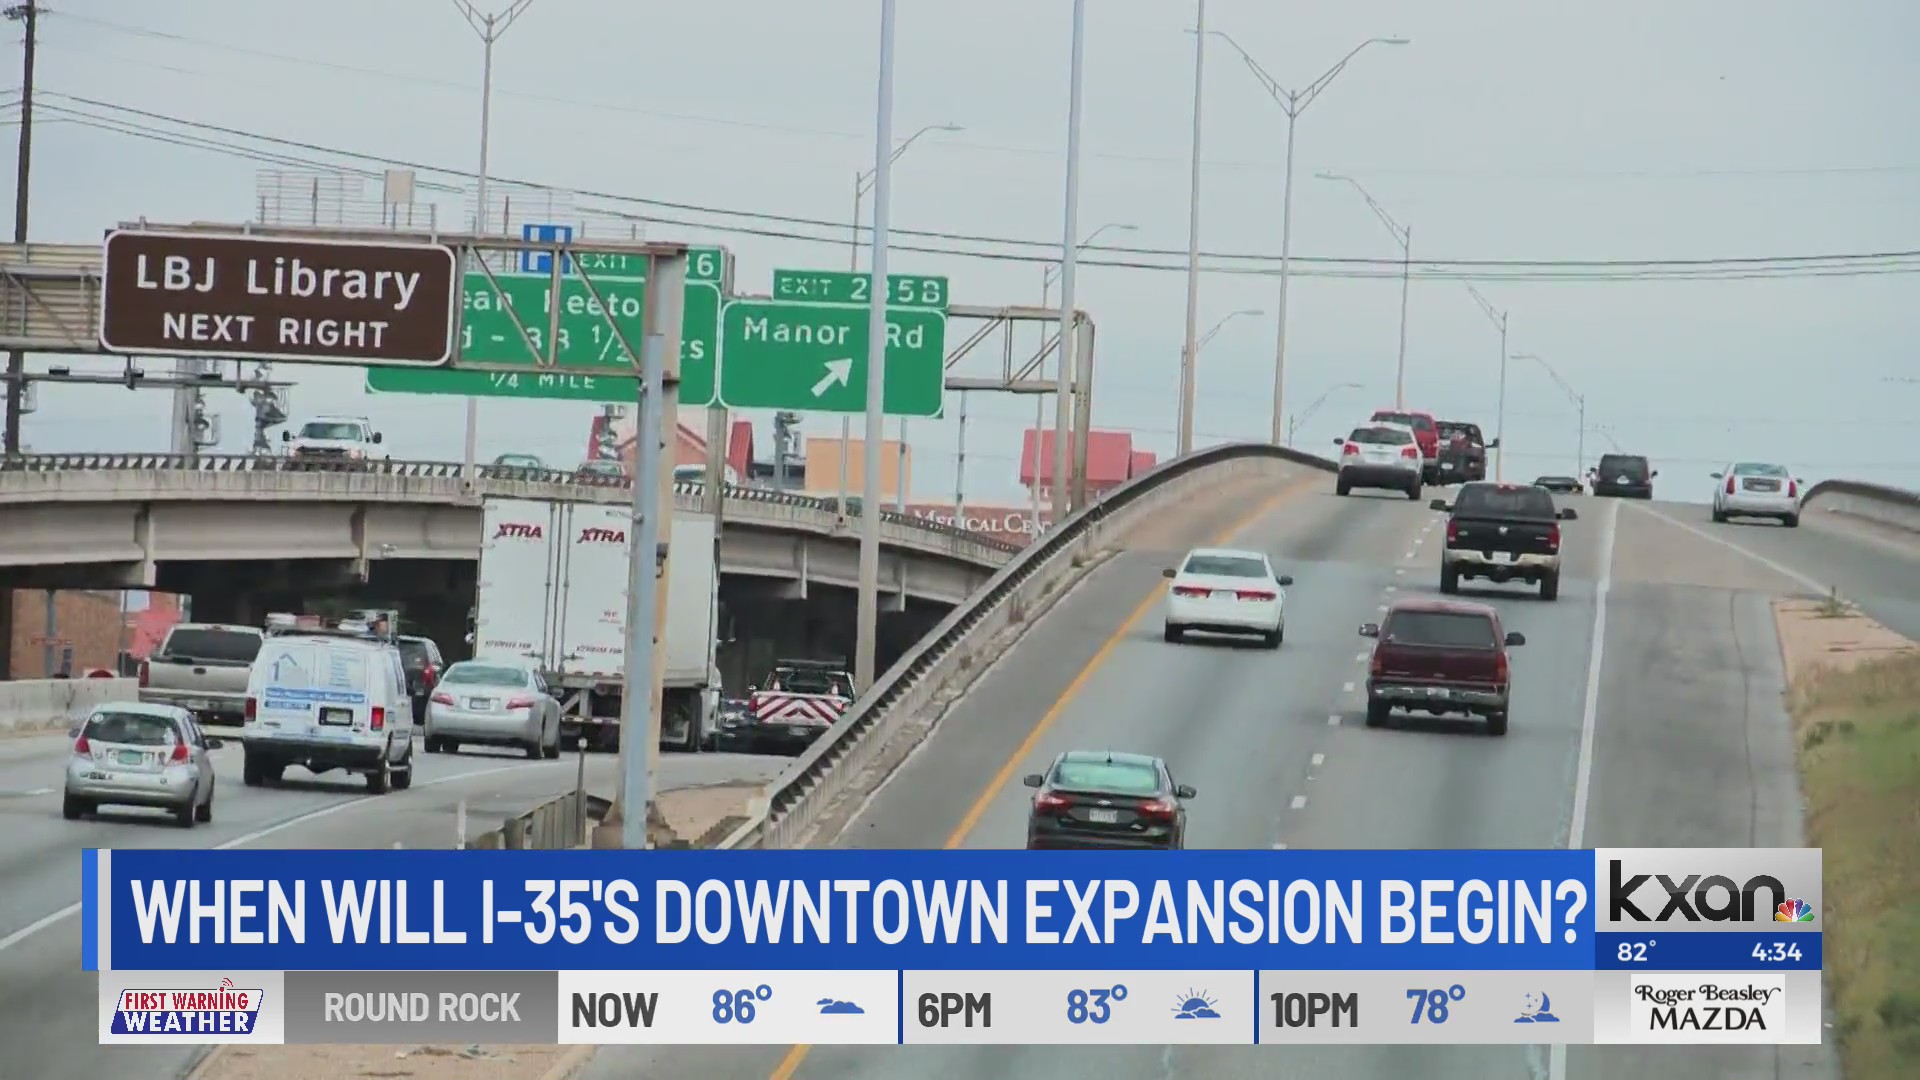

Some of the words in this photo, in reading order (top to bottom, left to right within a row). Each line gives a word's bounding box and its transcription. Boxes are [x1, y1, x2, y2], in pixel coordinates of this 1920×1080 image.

[579, 254, 627, 270] EXIT
[137, 254, 215, 292] LBJ
[247, 256, 420, 311] Library
[780, 277, 832, 295] EXIT
[463, 289, 513, 312] ean
[163, 312, 254, 342] NEXT
[278, 317, 389, 348] RIGHT
[743, 316, 850, 345] Manor
[885, 322, 923, 349] Rd
[538, 374, 595, 389] MILE
[493, 523, 543, 539] XTRA
[576, 527, 625, 544] XTRA
